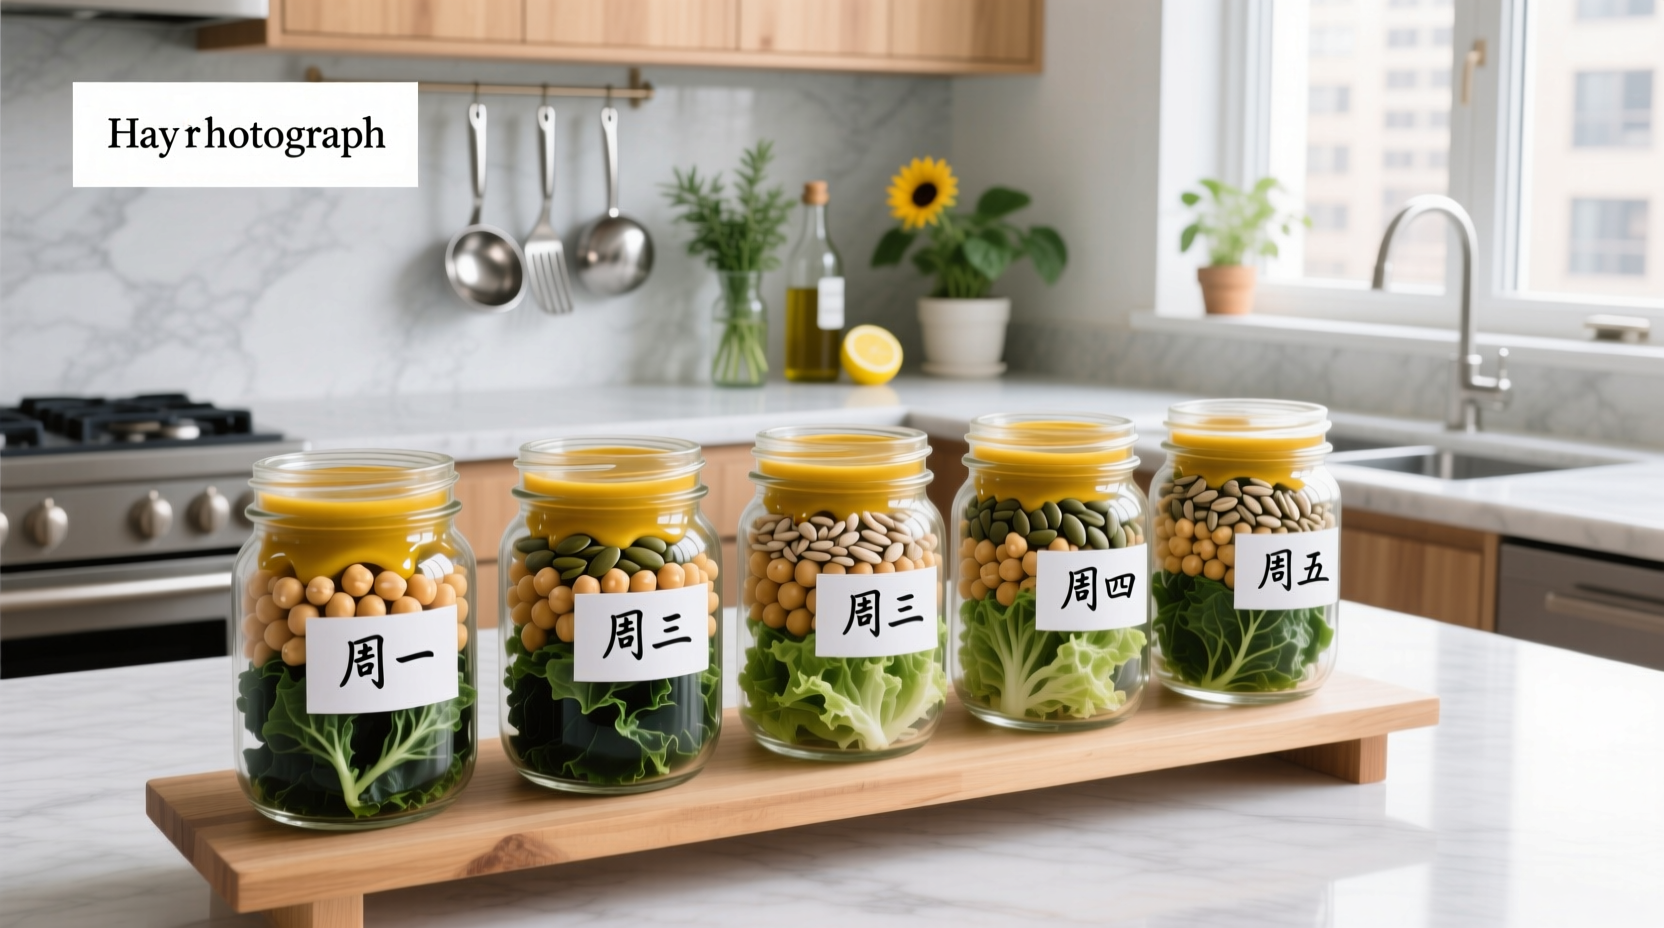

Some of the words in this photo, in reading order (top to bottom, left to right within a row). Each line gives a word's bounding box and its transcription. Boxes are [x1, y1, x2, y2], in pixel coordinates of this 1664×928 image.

[1060, 566, 1136, 612] 周四
[1257, 548, 1330, 592] 周五
[602, 609, 692, 661] 周三
[842, 589, 924, 638] 周三
[339, 634, 434, 690] 周一
